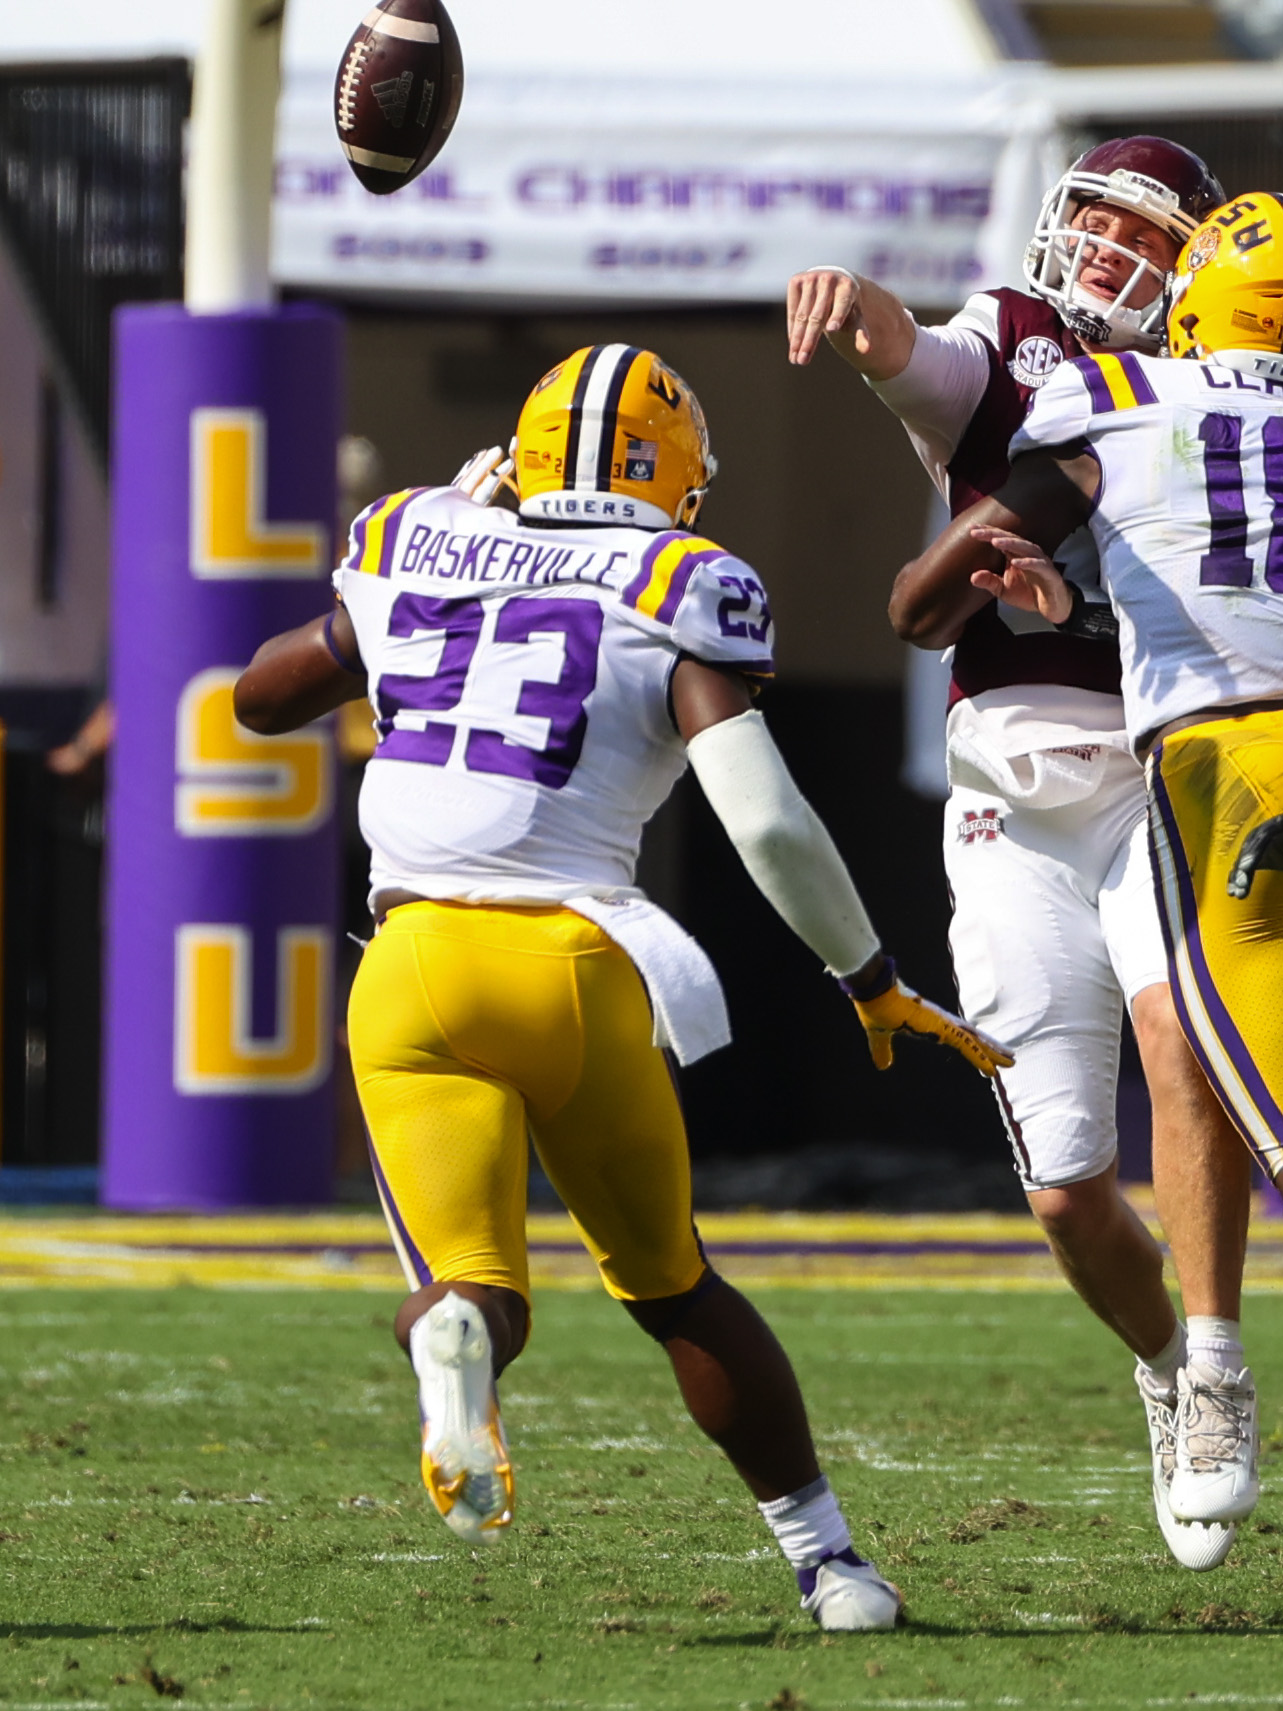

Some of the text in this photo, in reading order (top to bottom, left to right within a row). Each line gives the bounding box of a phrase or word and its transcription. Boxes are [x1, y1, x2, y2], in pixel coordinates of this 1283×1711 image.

[1012, 367, 1047, 387] GRADU
[1020, 338, 1060, 374] SEC
[540, 500, 636, 518] TIGERS
[400, 523, 628, 592] BASKERVILLE
[716, 574, 772, 644] 23
[371, 590, 605, 791] 23
[176, 408, 331, 1095] LSU
[963, 819, 996, 834] STATE
